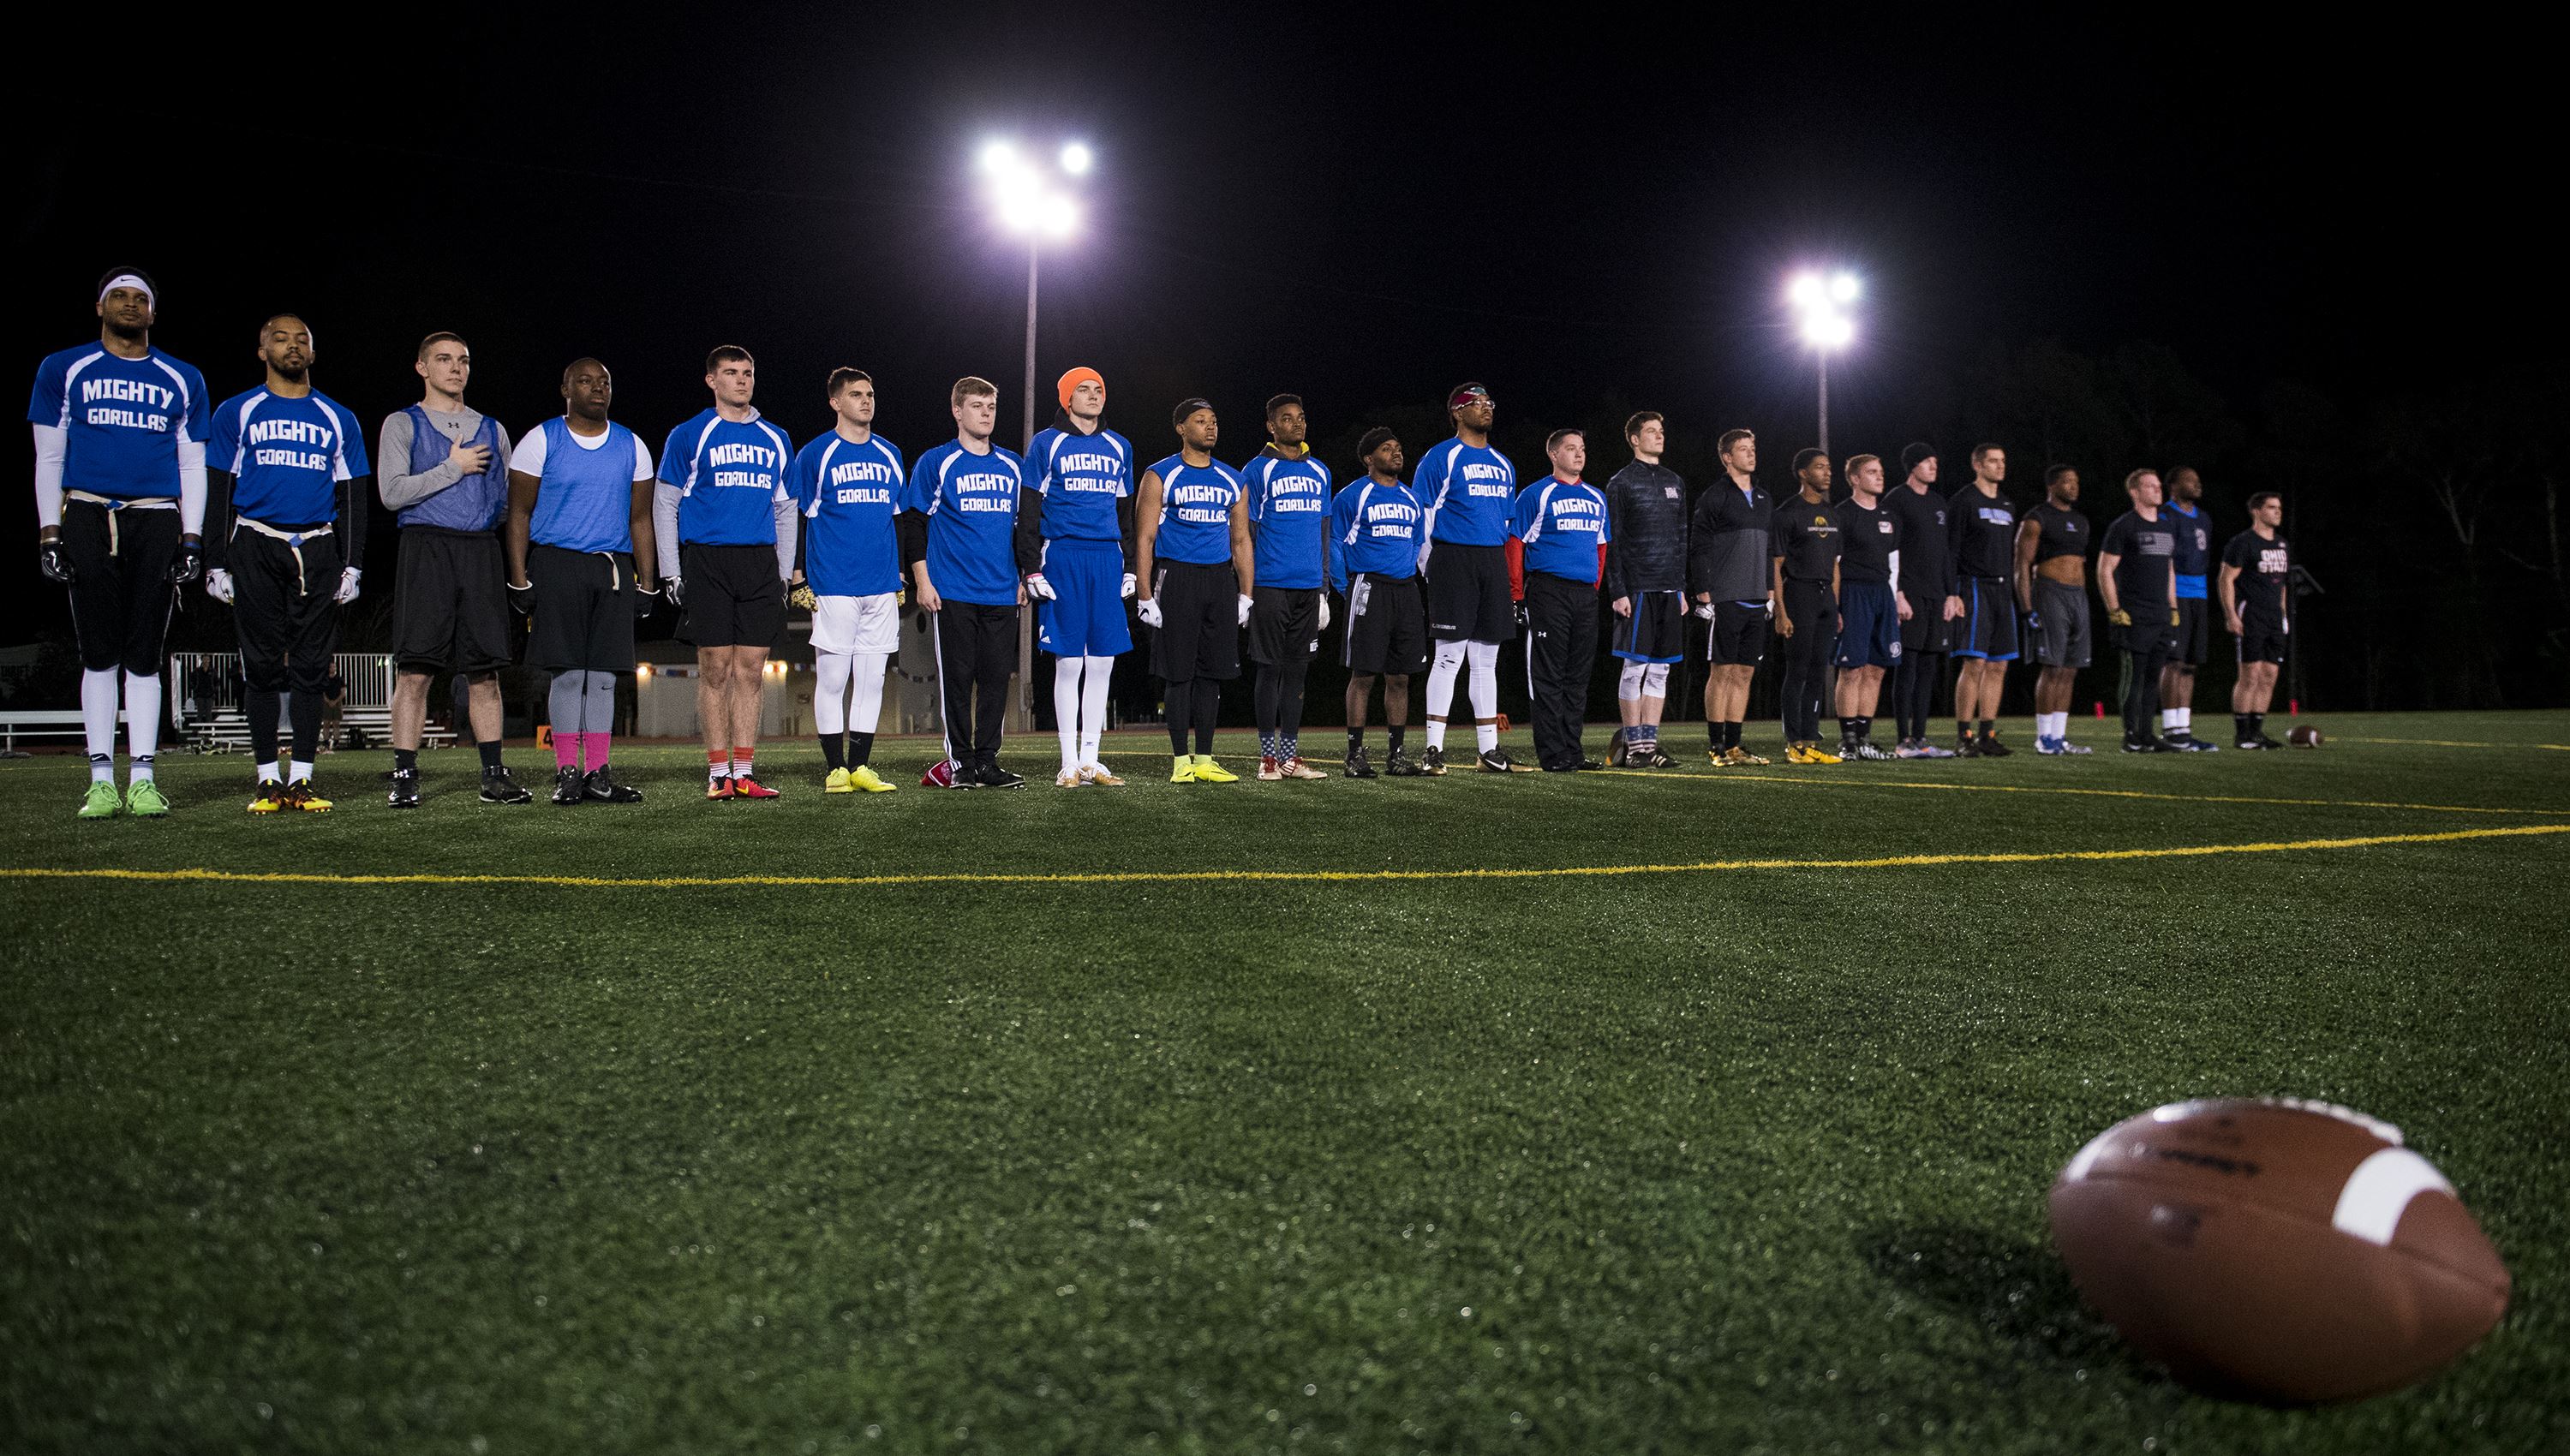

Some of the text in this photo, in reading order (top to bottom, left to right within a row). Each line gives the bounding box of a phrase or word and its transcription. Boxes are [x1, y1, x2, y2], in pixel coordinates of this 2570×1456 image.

[82, 379, 175, 409] MIGHTY
[87, 408, 168, 433] GORILLAS
[249, 419, 333, 449] MIGHTY
[255, 449, 327, 471] GORILLAS
[709, 443, 776, 468] MIGHTY
[1060, 453, 1121, 476] MIGHTY
[714, 470, 772, 490] GORILLAS
[830, 462, 892, 486] MIGHTY
[1463, 463, 1506, 482] MIGHTY
[956, 473, 1015, 495] MIGHTY
[1064, 477, 1117, 494] GORILLAS
[1271, 475, 1322, 498] MIGHTY
[837, 488, 891, 504] GORILLAS
[959, 498, 1012, 513] GORILLAS
[1174, 485, 1234, 507] MIGHTY
[1275, 498, 1322, 512] GORILLAS
[1178, 507, 1228, 523] GORILLAS
[1367, 503, 1417, 524] MIGHTY
[1551, 498, 1601, 517] MIGHTY
[1372, 524, 1414, 539] GORILLA
[1556, 518, 1601, 533] GORILLAS
[2261, 549, 2287, 561] OHIO
